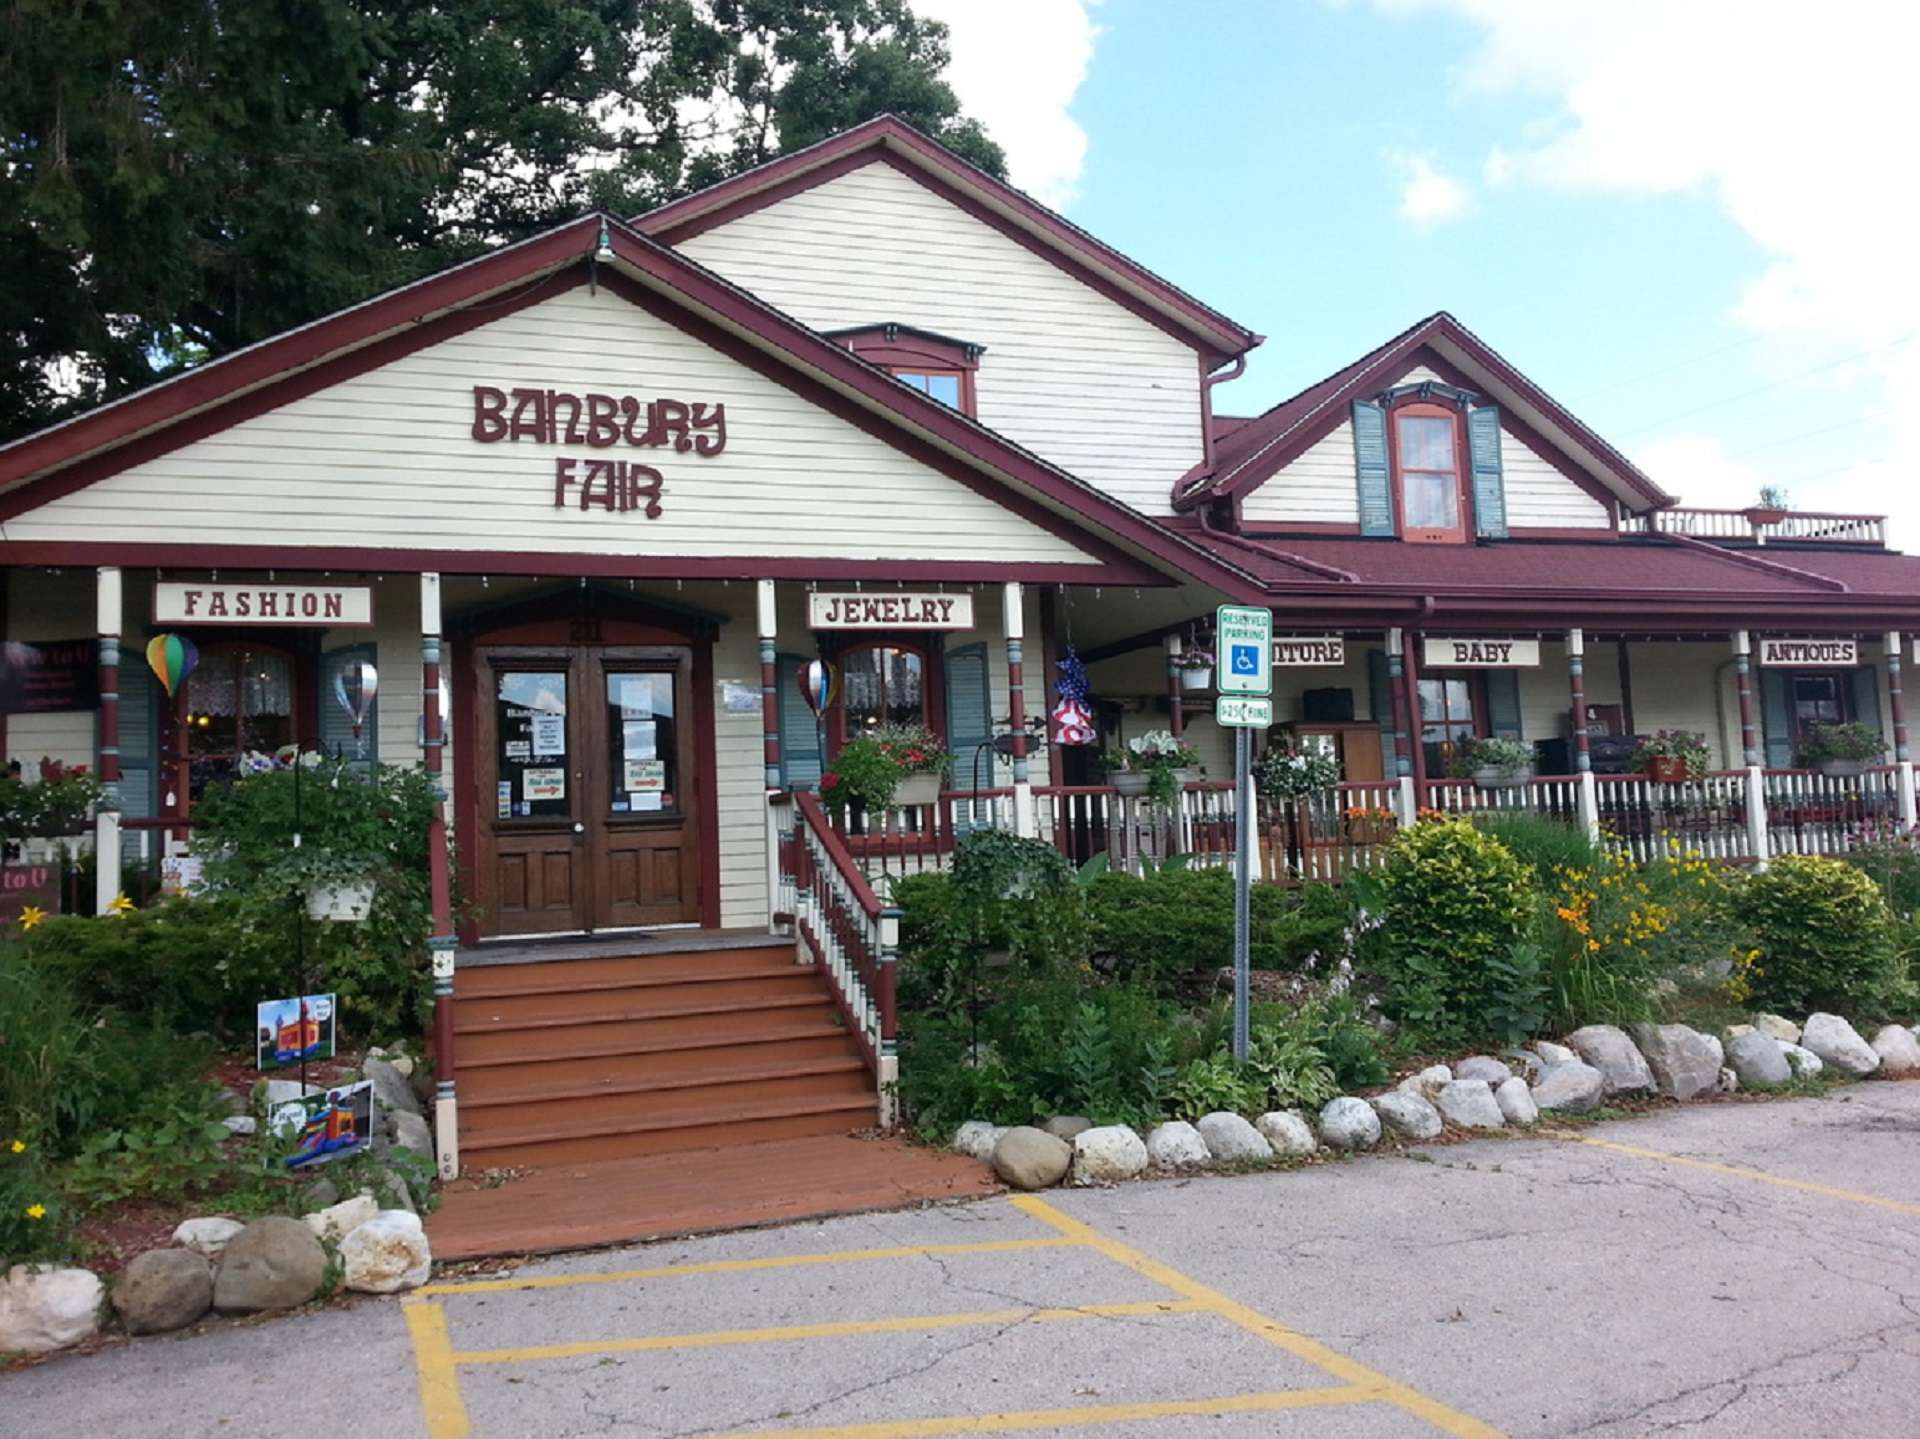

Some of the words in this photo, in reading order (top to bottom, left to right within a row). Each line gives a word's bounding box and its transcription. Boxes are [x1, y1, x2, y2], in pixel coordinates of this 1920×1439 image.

[472, 385, 727, 457] BANBURY
[554, 457, 663, 519] FAIR
[184, 591, 344, 618] FASHION
[826, 598, 955, 623] JEWELRY
[1223, 613, 1268, 627] RESERVED
[1224, 628, 1265, 641] PARKING
[1453, 641, 1513, 664] BABY
[1766, 641, 1855, 662] ANTIQUES
